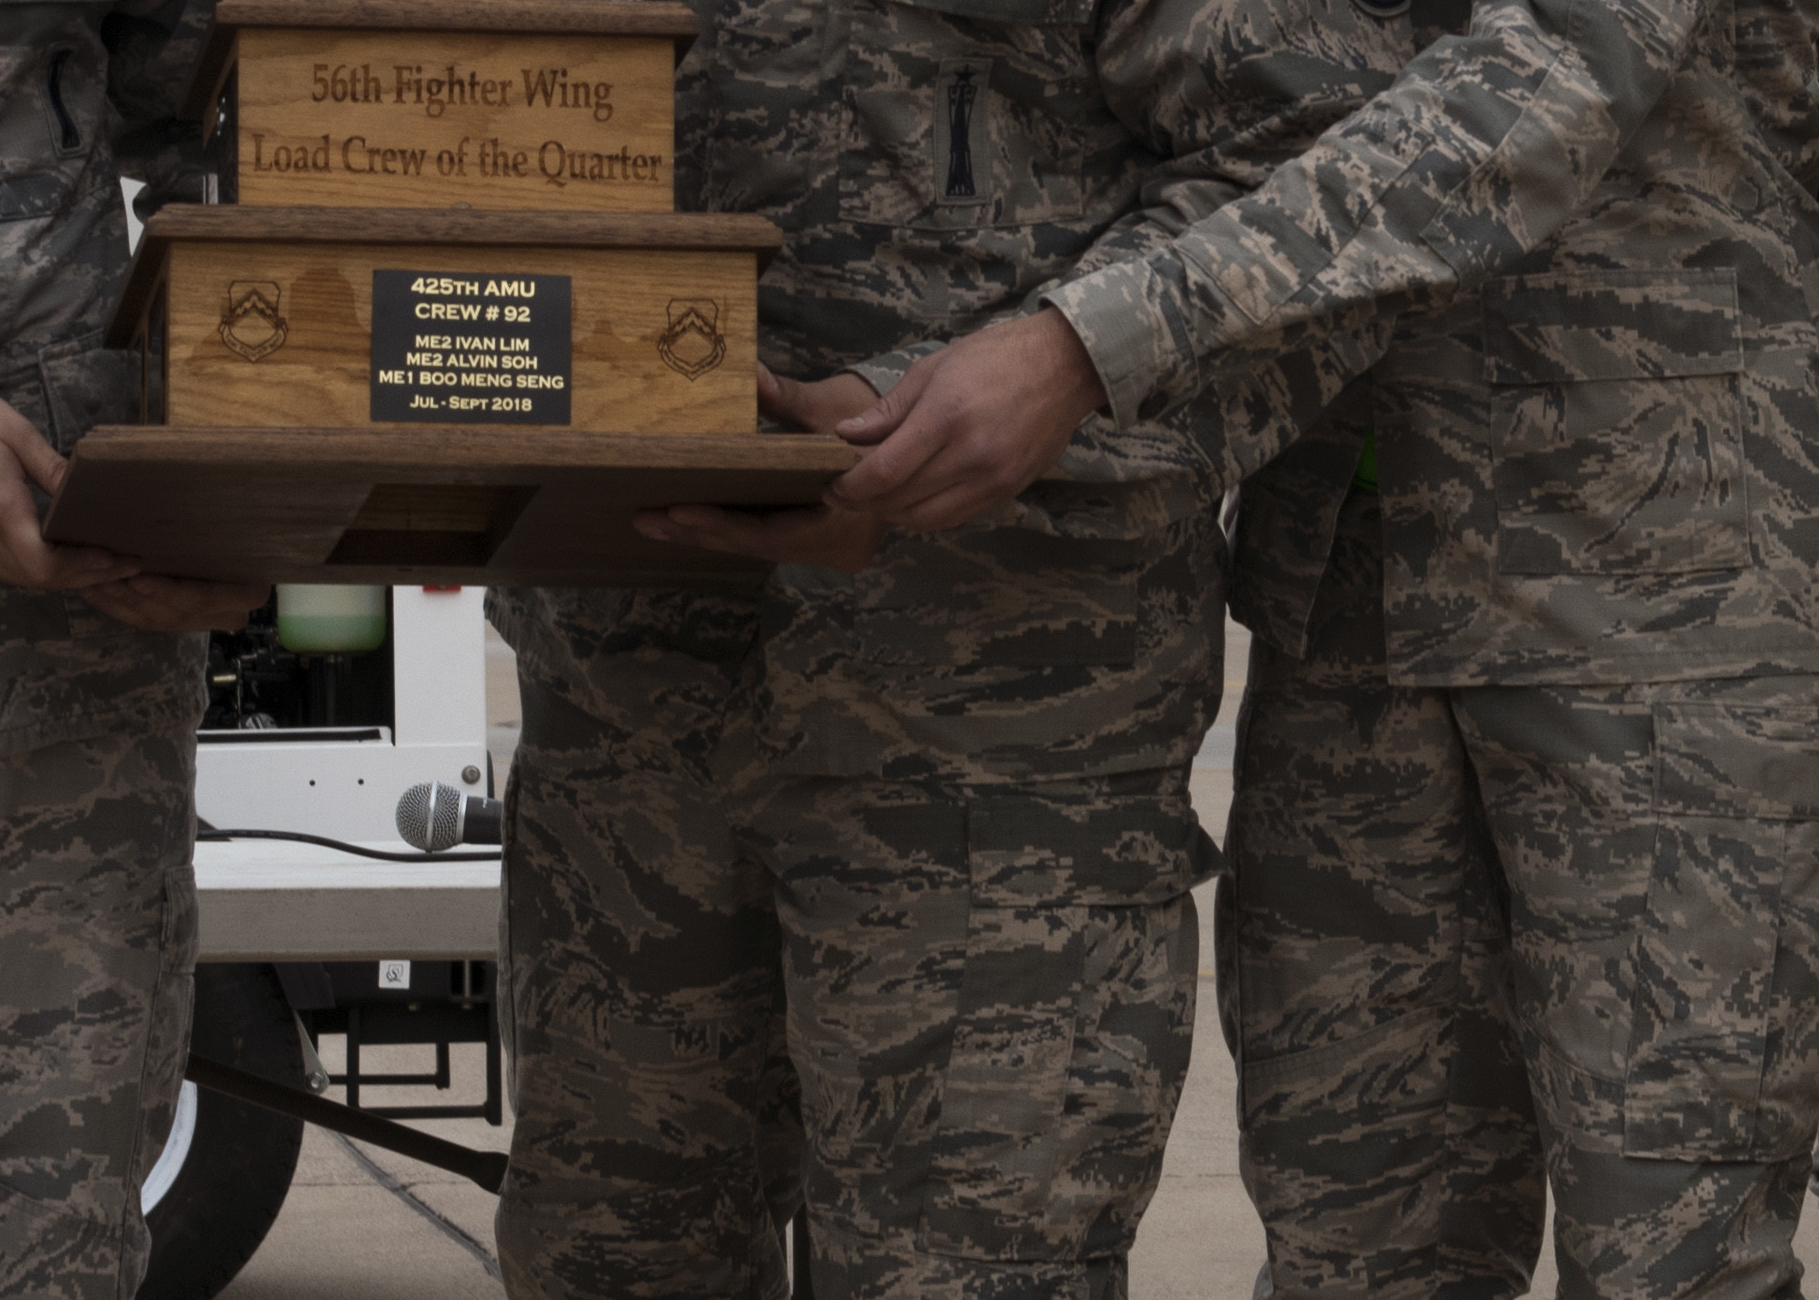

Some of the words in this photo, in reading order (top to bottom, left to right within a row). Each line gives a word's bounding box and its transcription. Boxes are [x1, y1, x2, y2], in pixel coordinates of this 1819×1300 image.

[311, 63, 383, 104] 56th
[393, 65, 513, 118] Fighter
[522, 68, 614, 122] Wing
[251, 134, 331, 173] Load
[342, 136, 426, 176] Crew
[437, 137, 471, 177] of
[478, 138, 528, 177] the
[538, 140, 662, 187] Quarter
[484, 280, 536, 297] AMU
[415, 303, 481, 320] CREW
[485, 305, 499, 320] #
[504, 306, 531, 322] 92
[415, 335, 452, 349] ME2
[456, 337, 495, 350] IVAN
[500, 338, 529, 351] LIM
[407, 352, 442, 366] ME2
[447, 354, 497, 368] ALVIN
[502, 356, 538, 369] SOH
[379, 370, 413, 384] ME1
[420, 371, 457, 385] BOO
[461, 373, 512, 387] MENG
[516, 375, 564, 389] SENG
[492, 397, 532, 411] 2018
